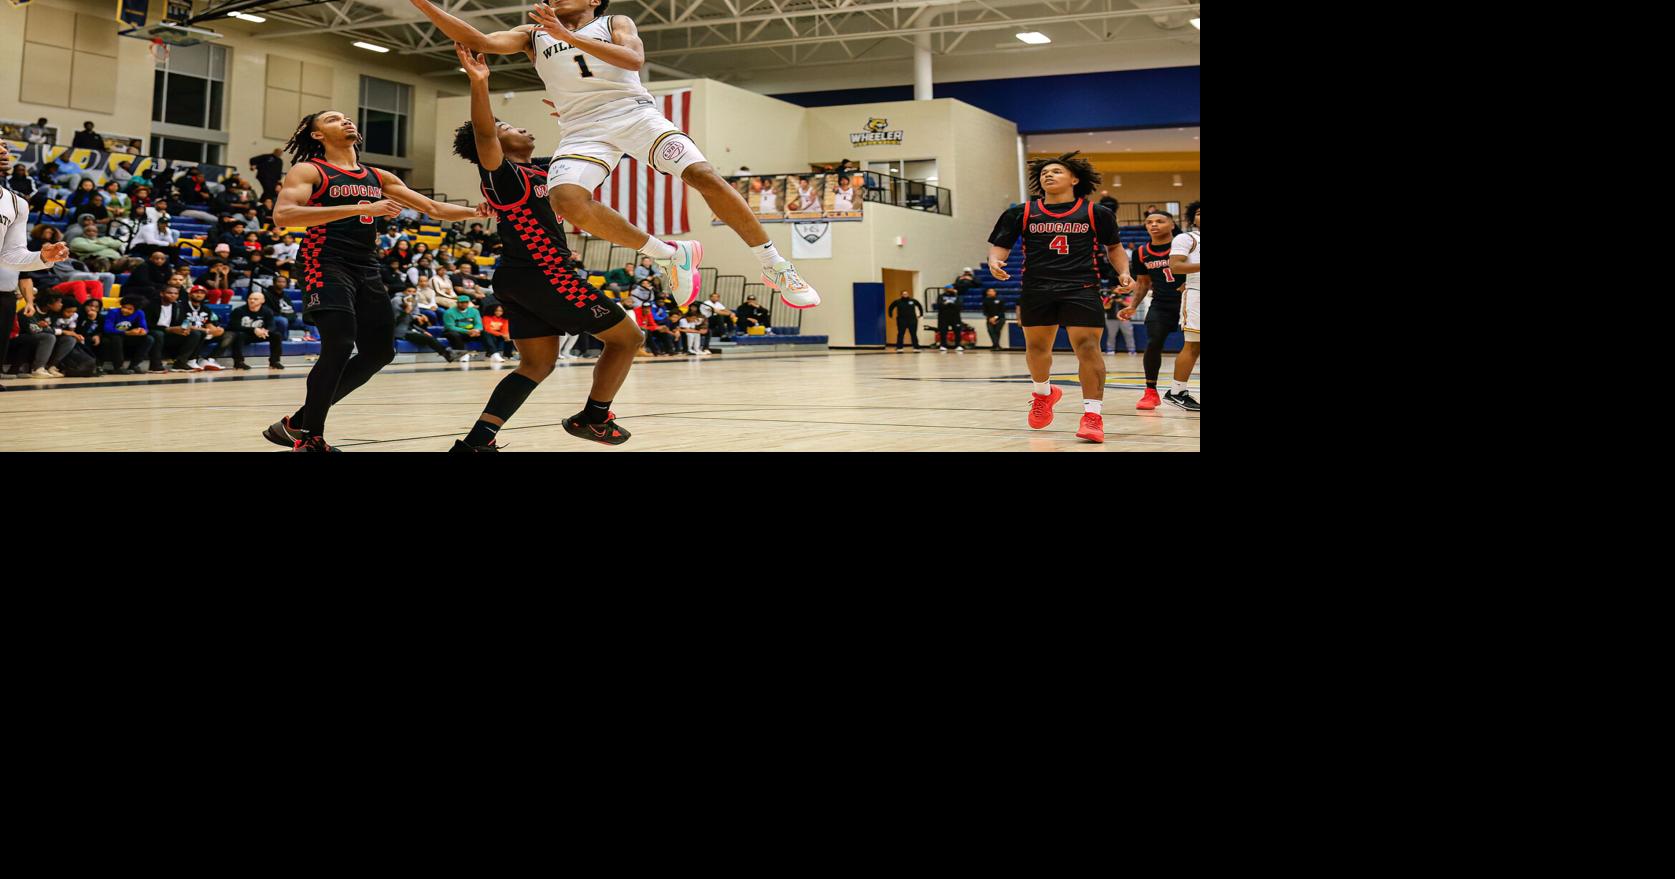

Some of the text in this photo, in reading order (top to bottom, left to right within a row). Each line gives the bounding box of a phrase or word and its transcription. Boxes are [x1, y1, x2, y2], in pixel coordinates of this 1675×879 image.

[574, 55, 594, 78] 1
[850, 130, 903, 144] WHEELER
[1029, 222, 1090, 234] COUGARS
[1049, 235, 1069, 255] 4
[1162, 268, 1175, 283] 1
